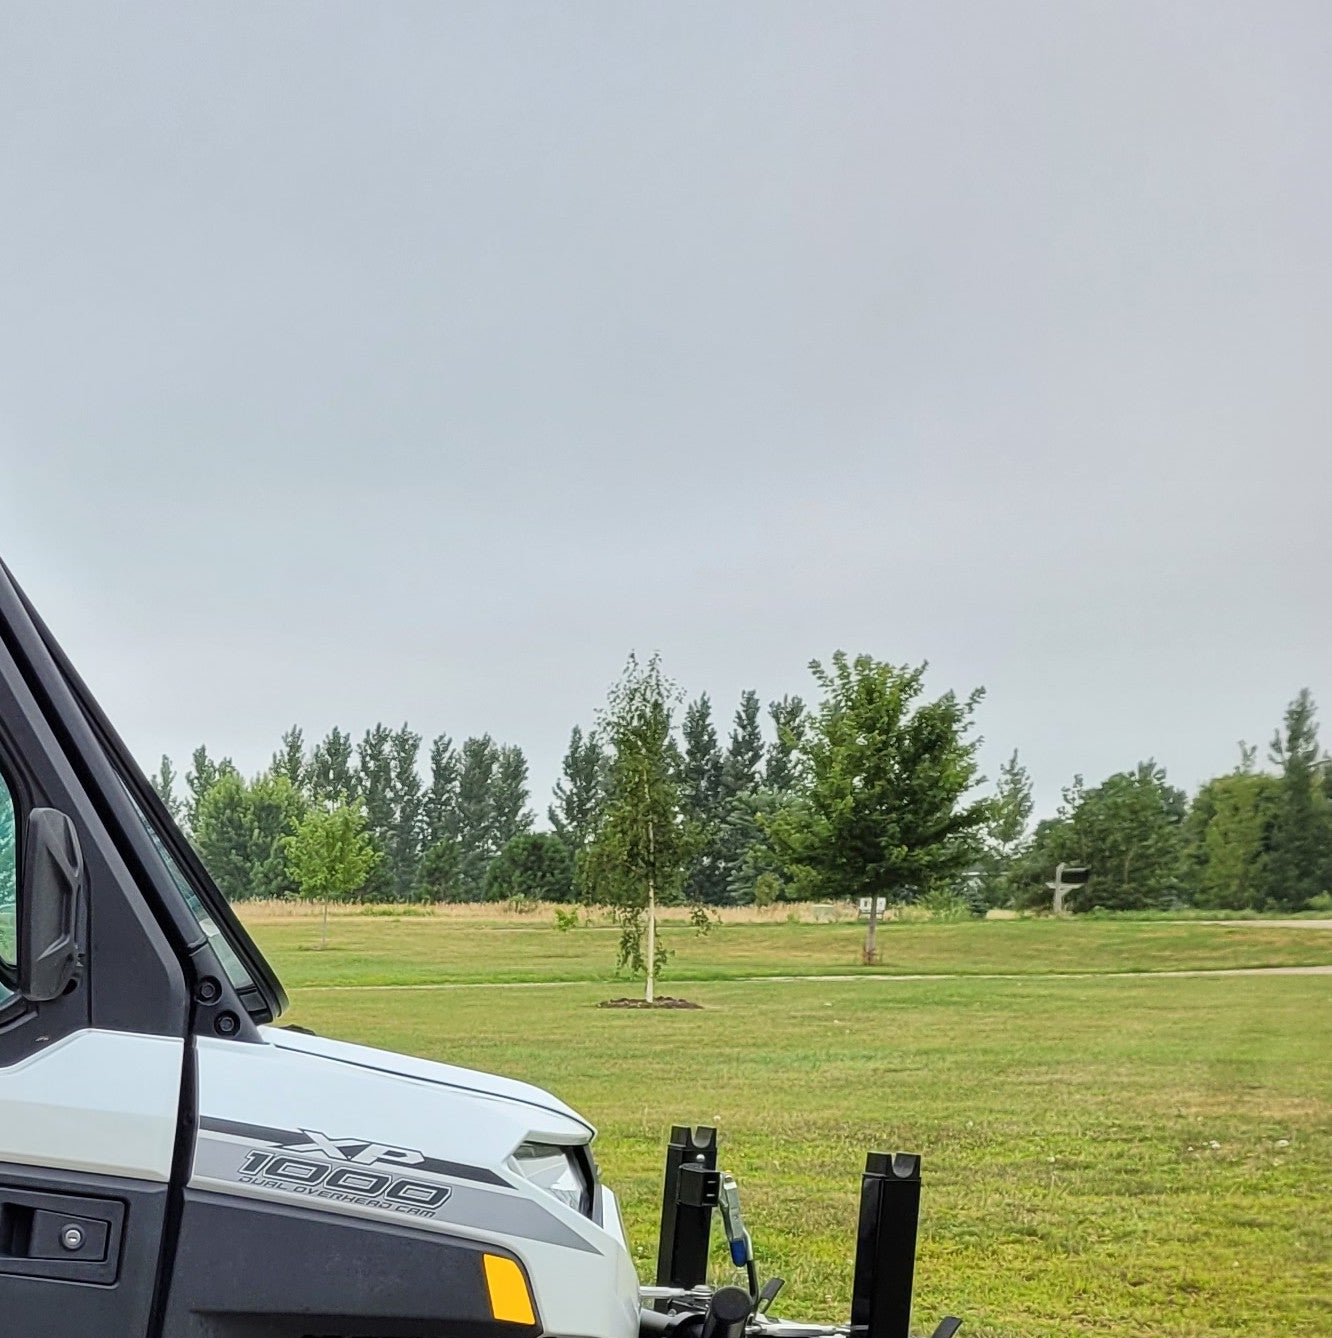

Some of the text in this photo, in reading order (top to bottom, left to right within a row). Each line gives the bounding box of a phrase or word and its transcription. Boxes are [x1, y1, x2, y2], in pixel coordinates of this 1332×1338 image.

[282, 1128, 425, 1165] XP
[238, 1149, 453, 1209] 1000
[239, 1176, 435, 1218] DUAL OVERHEAD CAM
